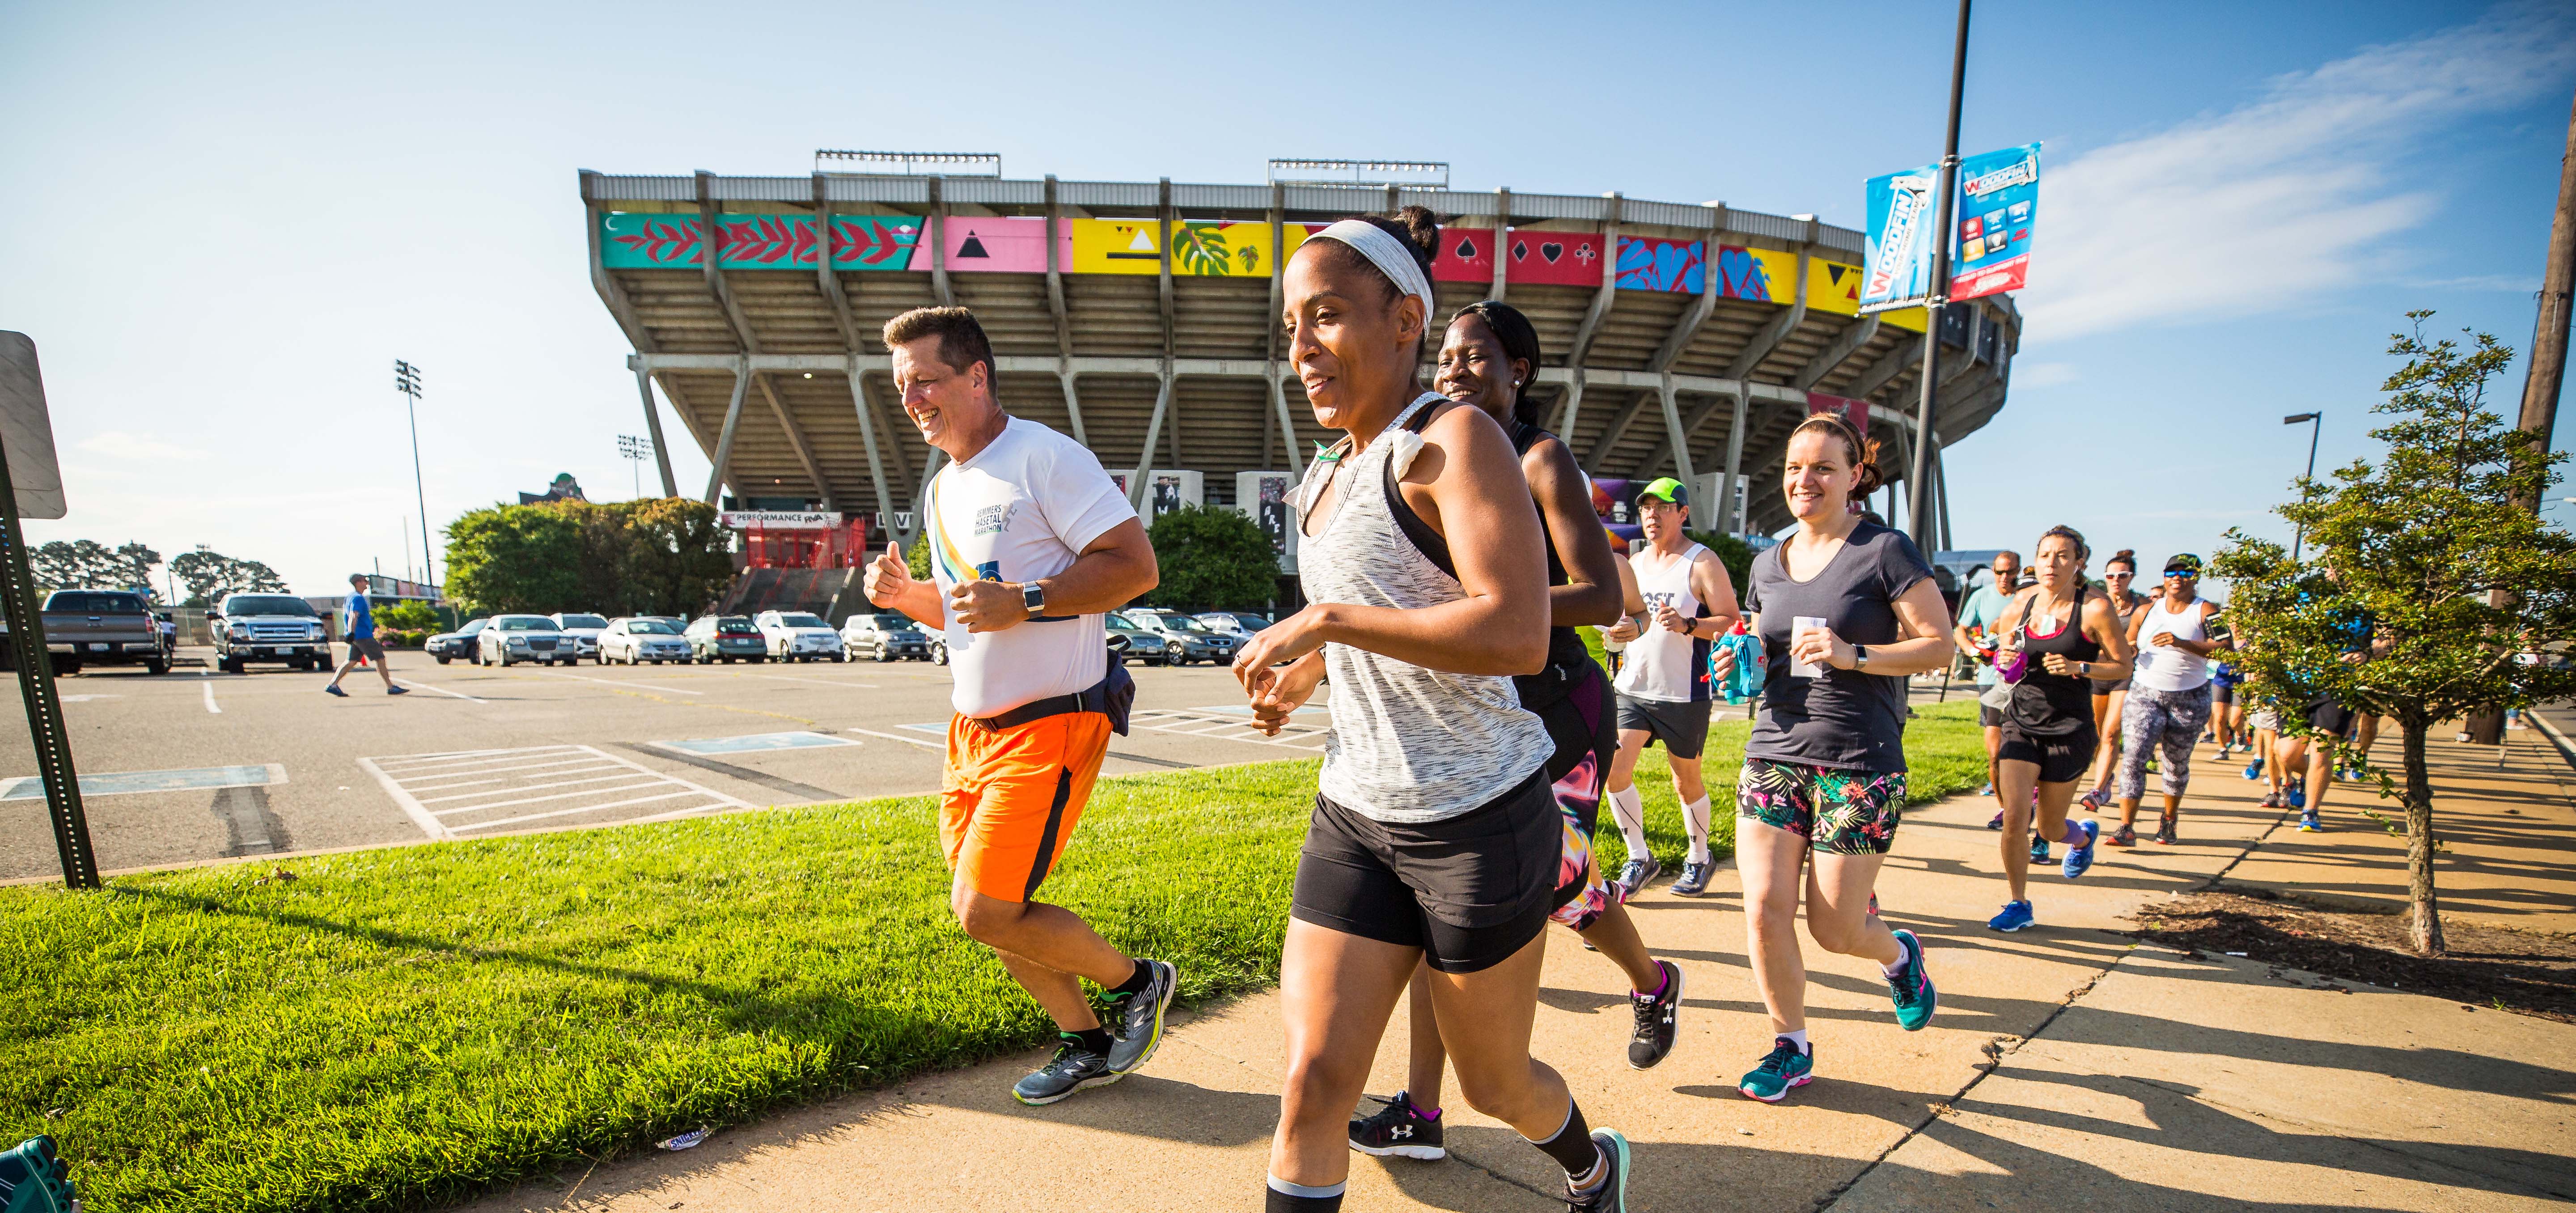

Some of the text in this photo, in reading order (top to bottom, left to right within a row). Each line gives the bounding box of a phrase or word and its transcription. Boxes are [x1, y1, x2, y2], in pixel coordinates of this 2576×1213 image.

[1869, 193, 1912, 295] WOODFIN
[977, 505, 1001, 517] REMMERS
[805, 514, 823, 523] RVA
[975, 513, 1001, 528] HASETAL
[974, 524, 1001, 535] MARATHON
